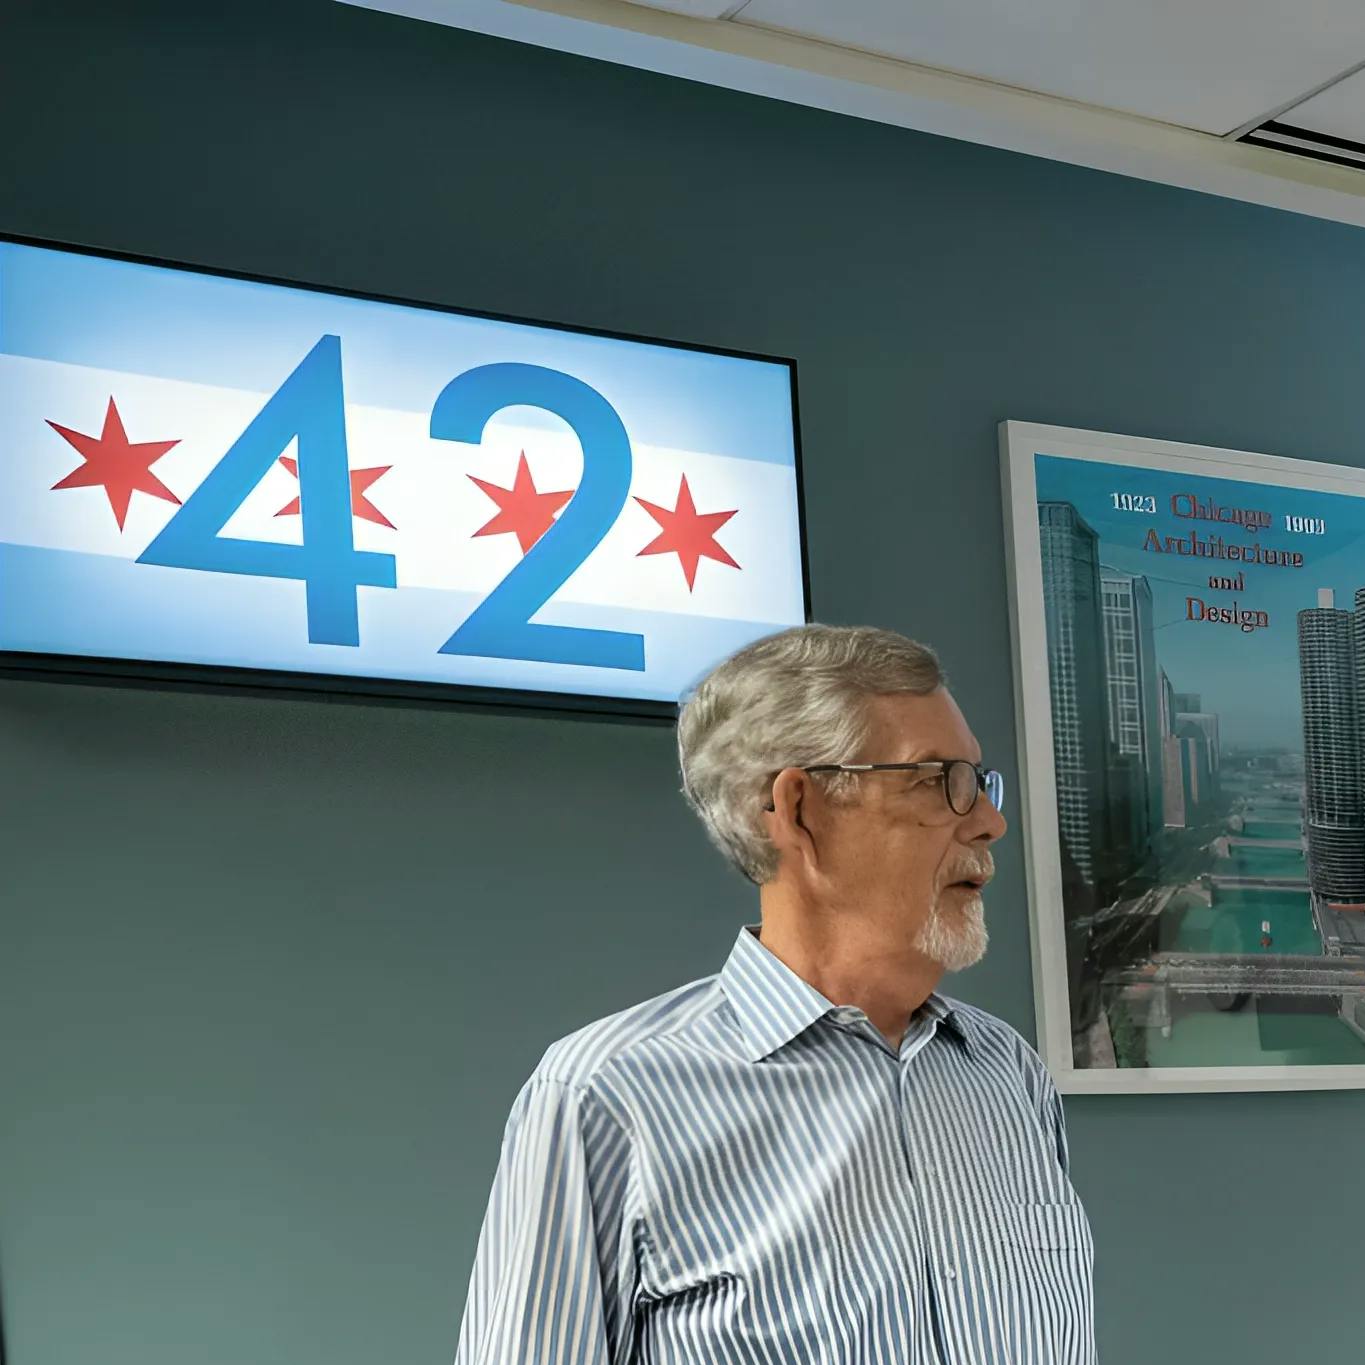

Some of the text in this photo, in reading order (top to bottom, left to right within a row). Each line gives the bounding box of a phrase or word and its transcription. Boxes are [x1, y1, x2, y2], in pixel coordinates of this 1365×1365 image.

[135, 334, 646, 672] 42
[1170, 493, 1272, 531] Chicago
[1143, 528, 1304, 568] Architecture
[1208, 571, 1245, 592] and
[1185, 596, 1268, 633] Design
